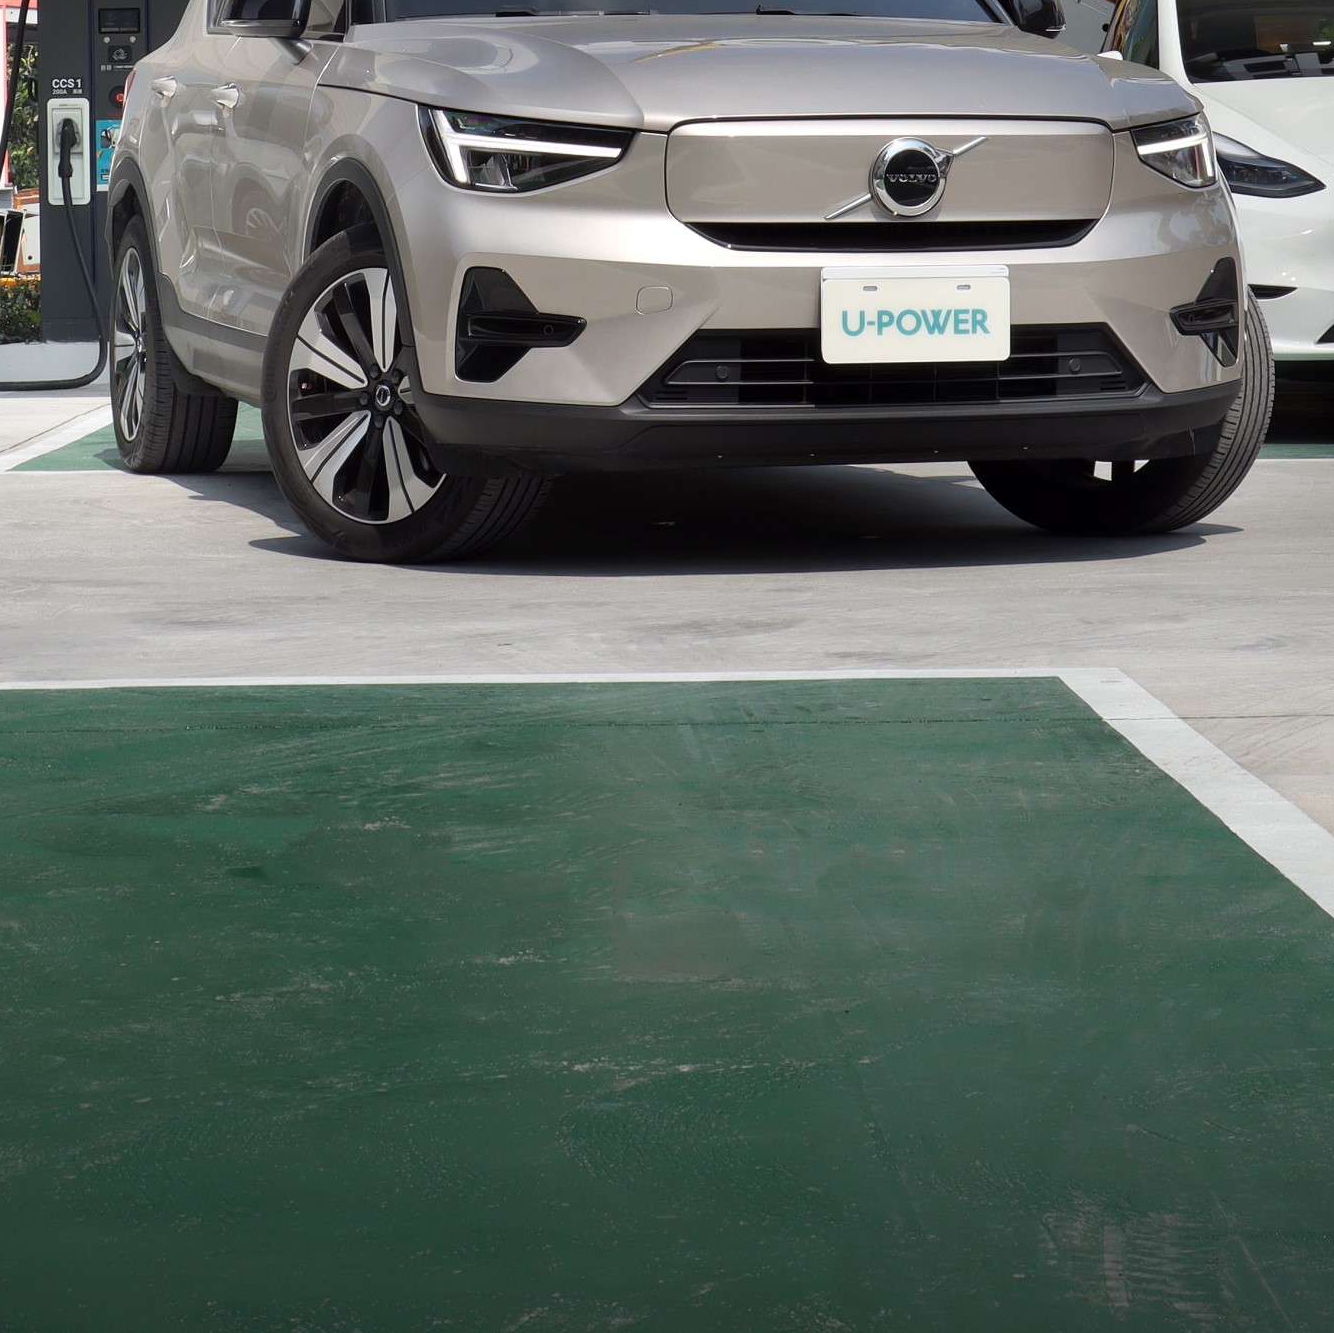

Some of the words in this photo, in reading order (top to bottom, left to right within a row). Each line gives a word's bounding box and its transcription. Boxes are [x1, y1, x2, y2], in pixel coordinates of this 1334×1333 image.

[51, 78, 82, 88] CCS1
[886, 174, 937, 183] VOLVO
[842, 308, 991, 337] U-POWER
